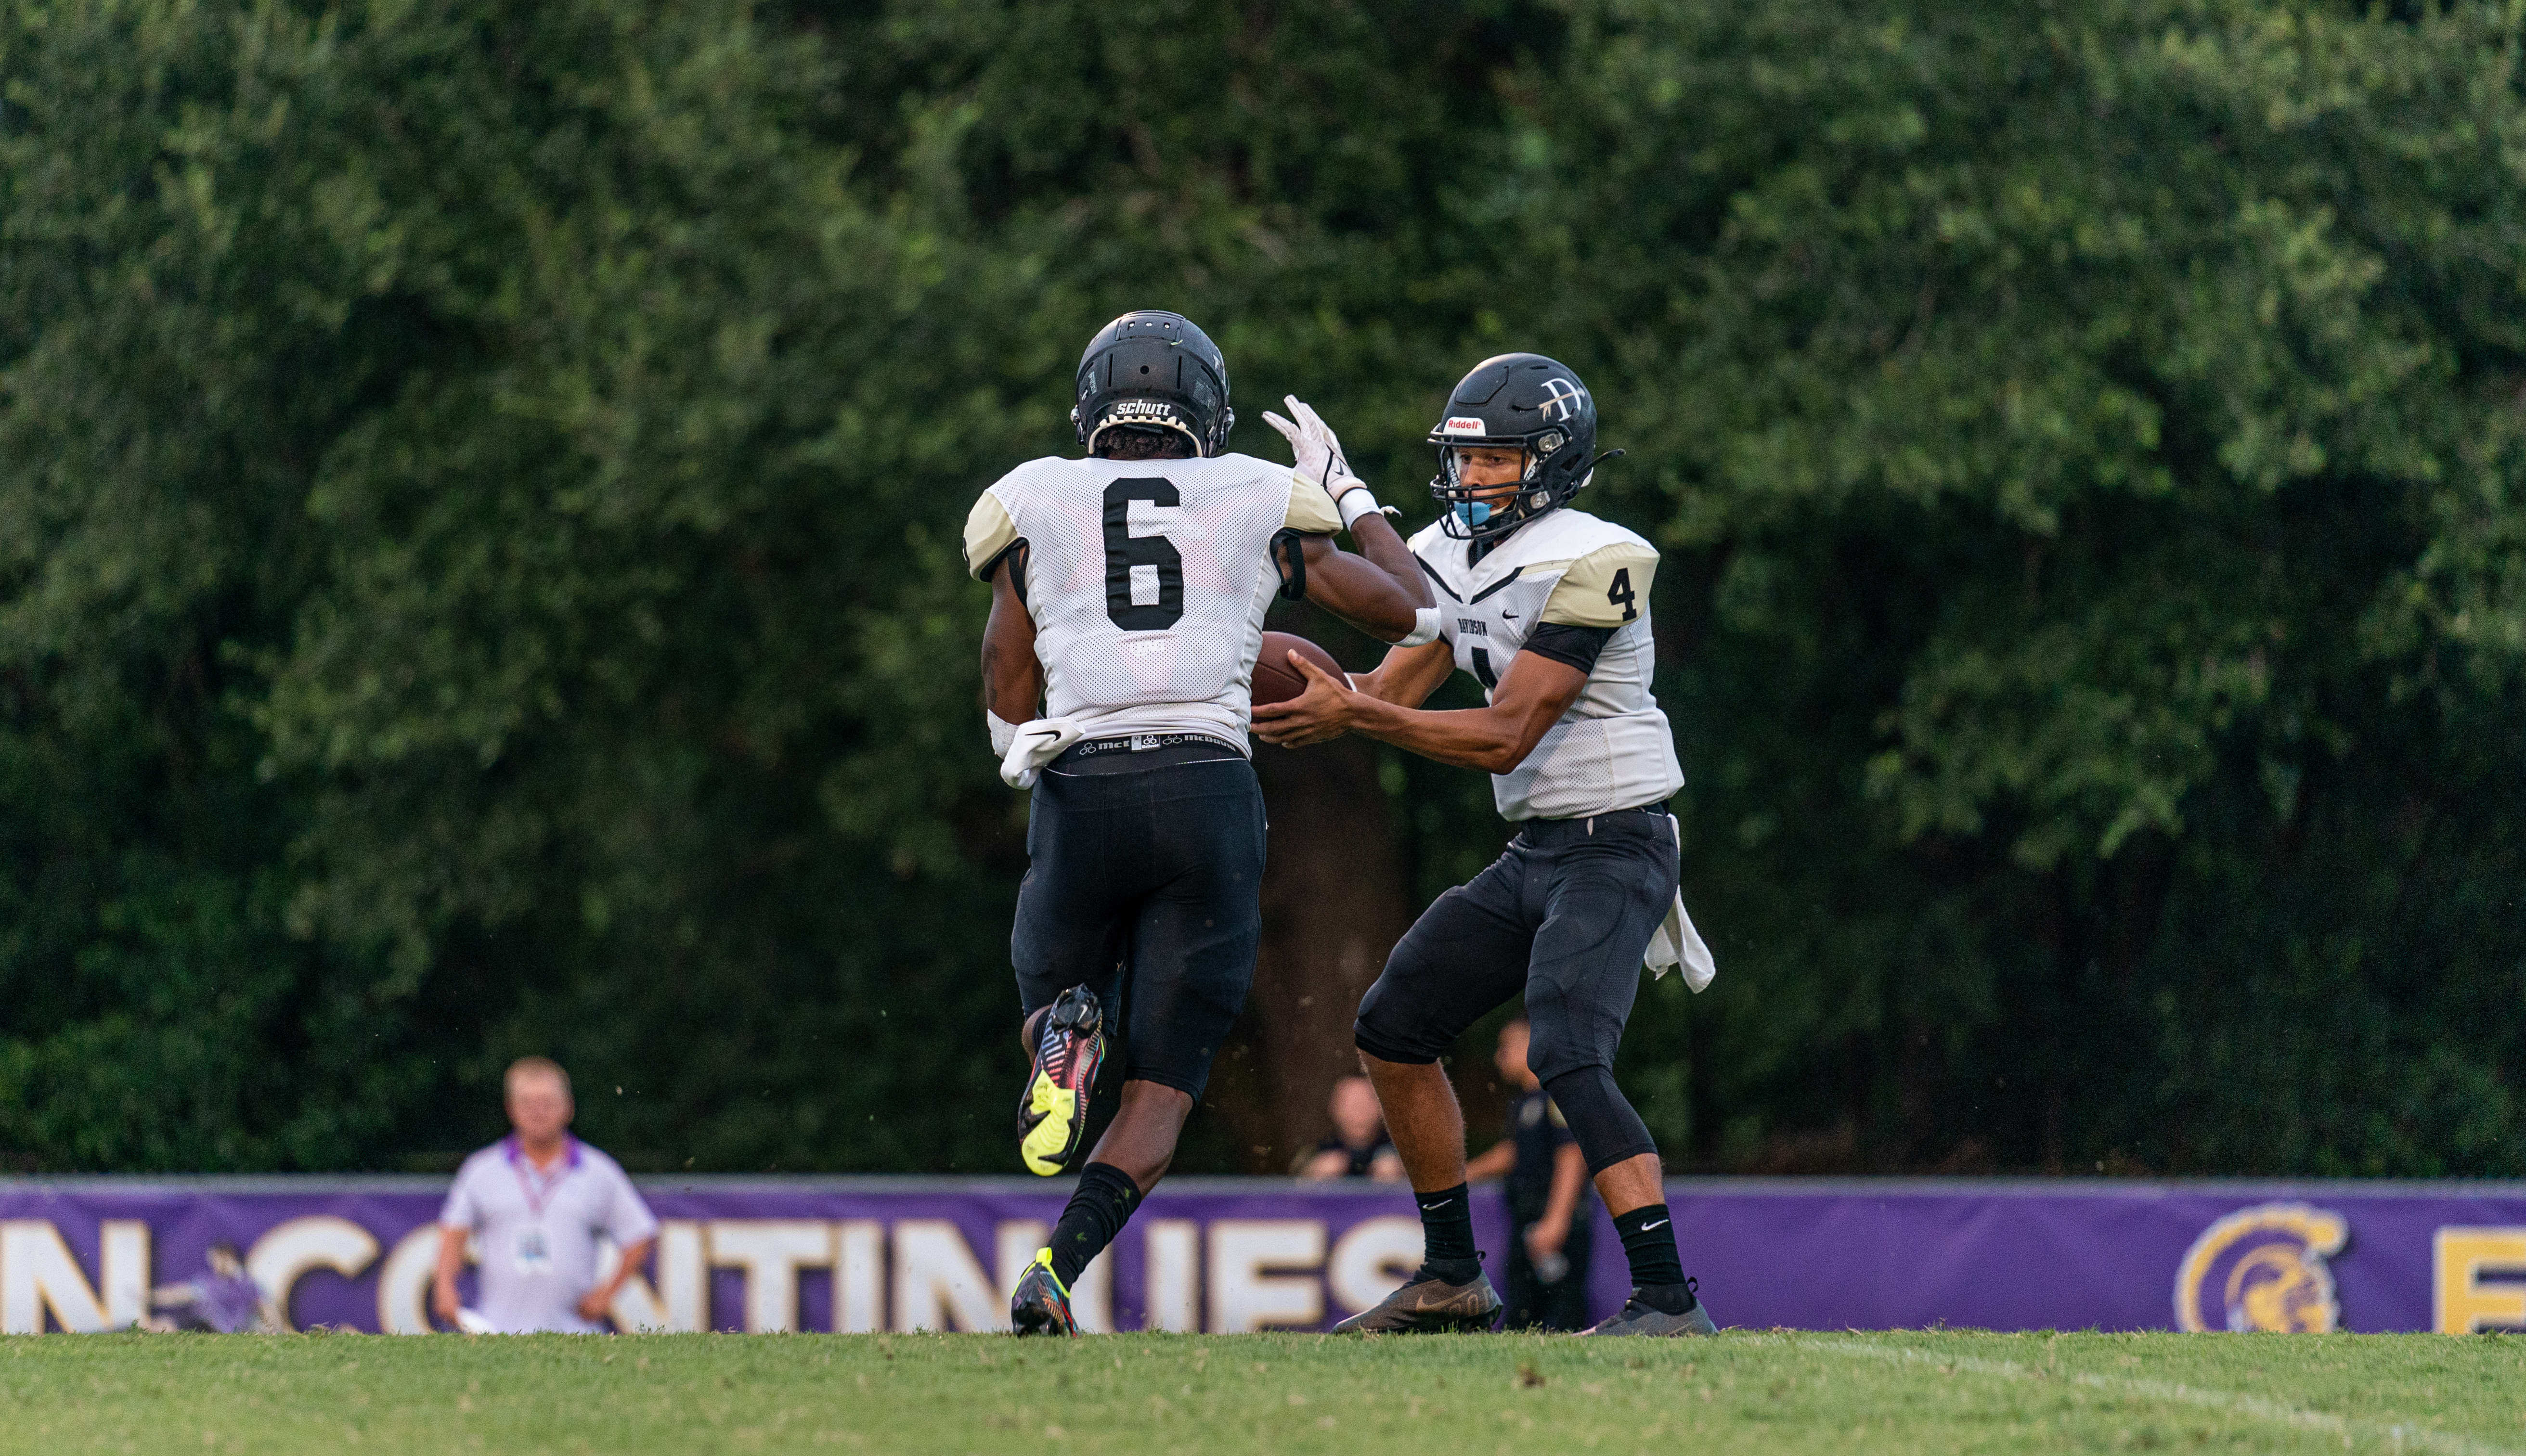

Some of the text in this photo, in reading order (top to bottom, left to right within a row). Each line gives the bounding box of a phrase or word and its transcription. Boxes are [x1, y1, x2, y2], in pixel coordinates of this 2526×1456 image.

[1116, 399, 1171, 416] schutt
[1448, 420, 1478, 429] Riddell
[1102, 477, 1184, 631] 6
[1607, 567, 1637, 622] 4
[1457, 618, 1488, 637] DAVIDSON
